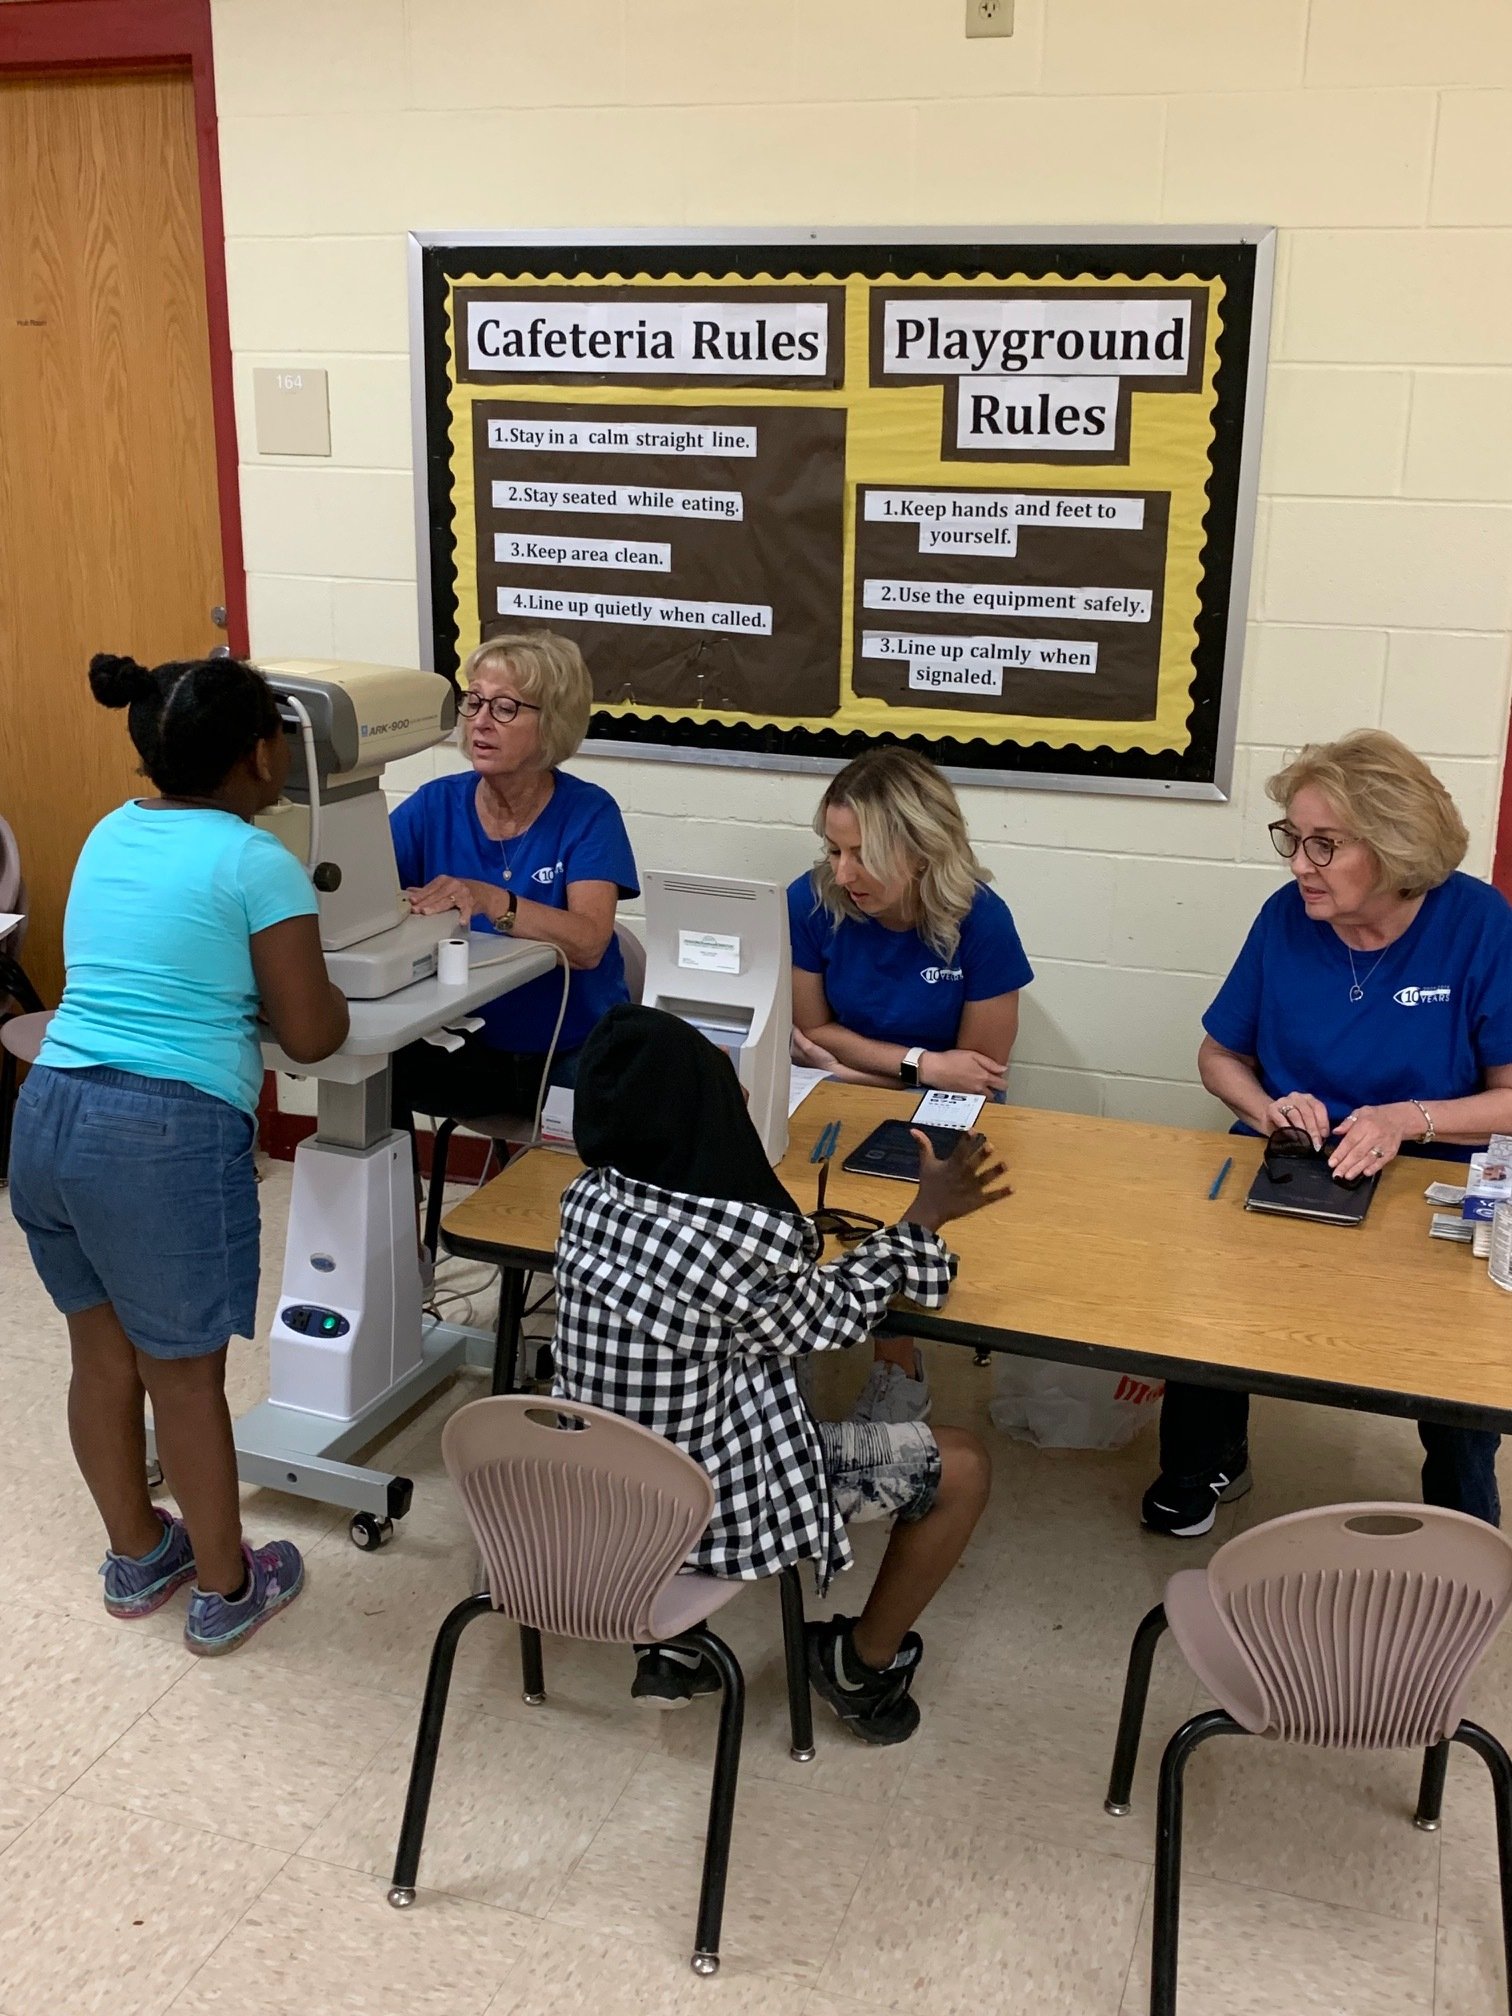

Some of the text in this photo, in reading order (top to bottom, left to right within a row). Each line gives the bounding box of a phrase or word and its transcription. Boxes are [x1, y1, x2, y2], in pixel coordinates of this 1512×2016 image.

[477, 318, 819, 361] Cafeteria Rules
[895, 317, 1185, 370] Playground
[277, 374, 303, 390] 164
[969, 393, 1106, 436] Rules
[549, 428, 564, 444] in
[569, 433, 578, 445] a
[588, 428, 629, 445] calm
[636, 431, 703, 452] straight
[712, 431, 750, 449] line.
[562, 490, 617, 506] seated
[627, 491, 674, 508] while
[681, 496, 739, 517] eating.
[952, 500, 1008, 518] hands
[1014, 500, 1050, 517] and
[1056, 500, 1093, 518] feet
[1097, 503, 1117, 519] to
[929, 527, 1011, 547] yourself.
[571, 549, 609, 562] area
[615, 547, 663, 565] clean.
[936, 588, 965, 605] the
[973, 590, 1076, 611] equipment
[1083, 595, 1145, 617] safely.
[568, 601, 589, 617] up
[592, 601, 652, 623] quietly
[659, 606, 705, 624] when
[711, 610, 766, 628] called.
[941, 645, 964, 662] up
[970, 643, 1032, 666] calmly
[1040, 647, 1091, 666] when
[916, 666, 996, 686] signaled.
[368, 718, 410, 737] ARK-900
[1420, 993, 1450, 1004] YEARS
